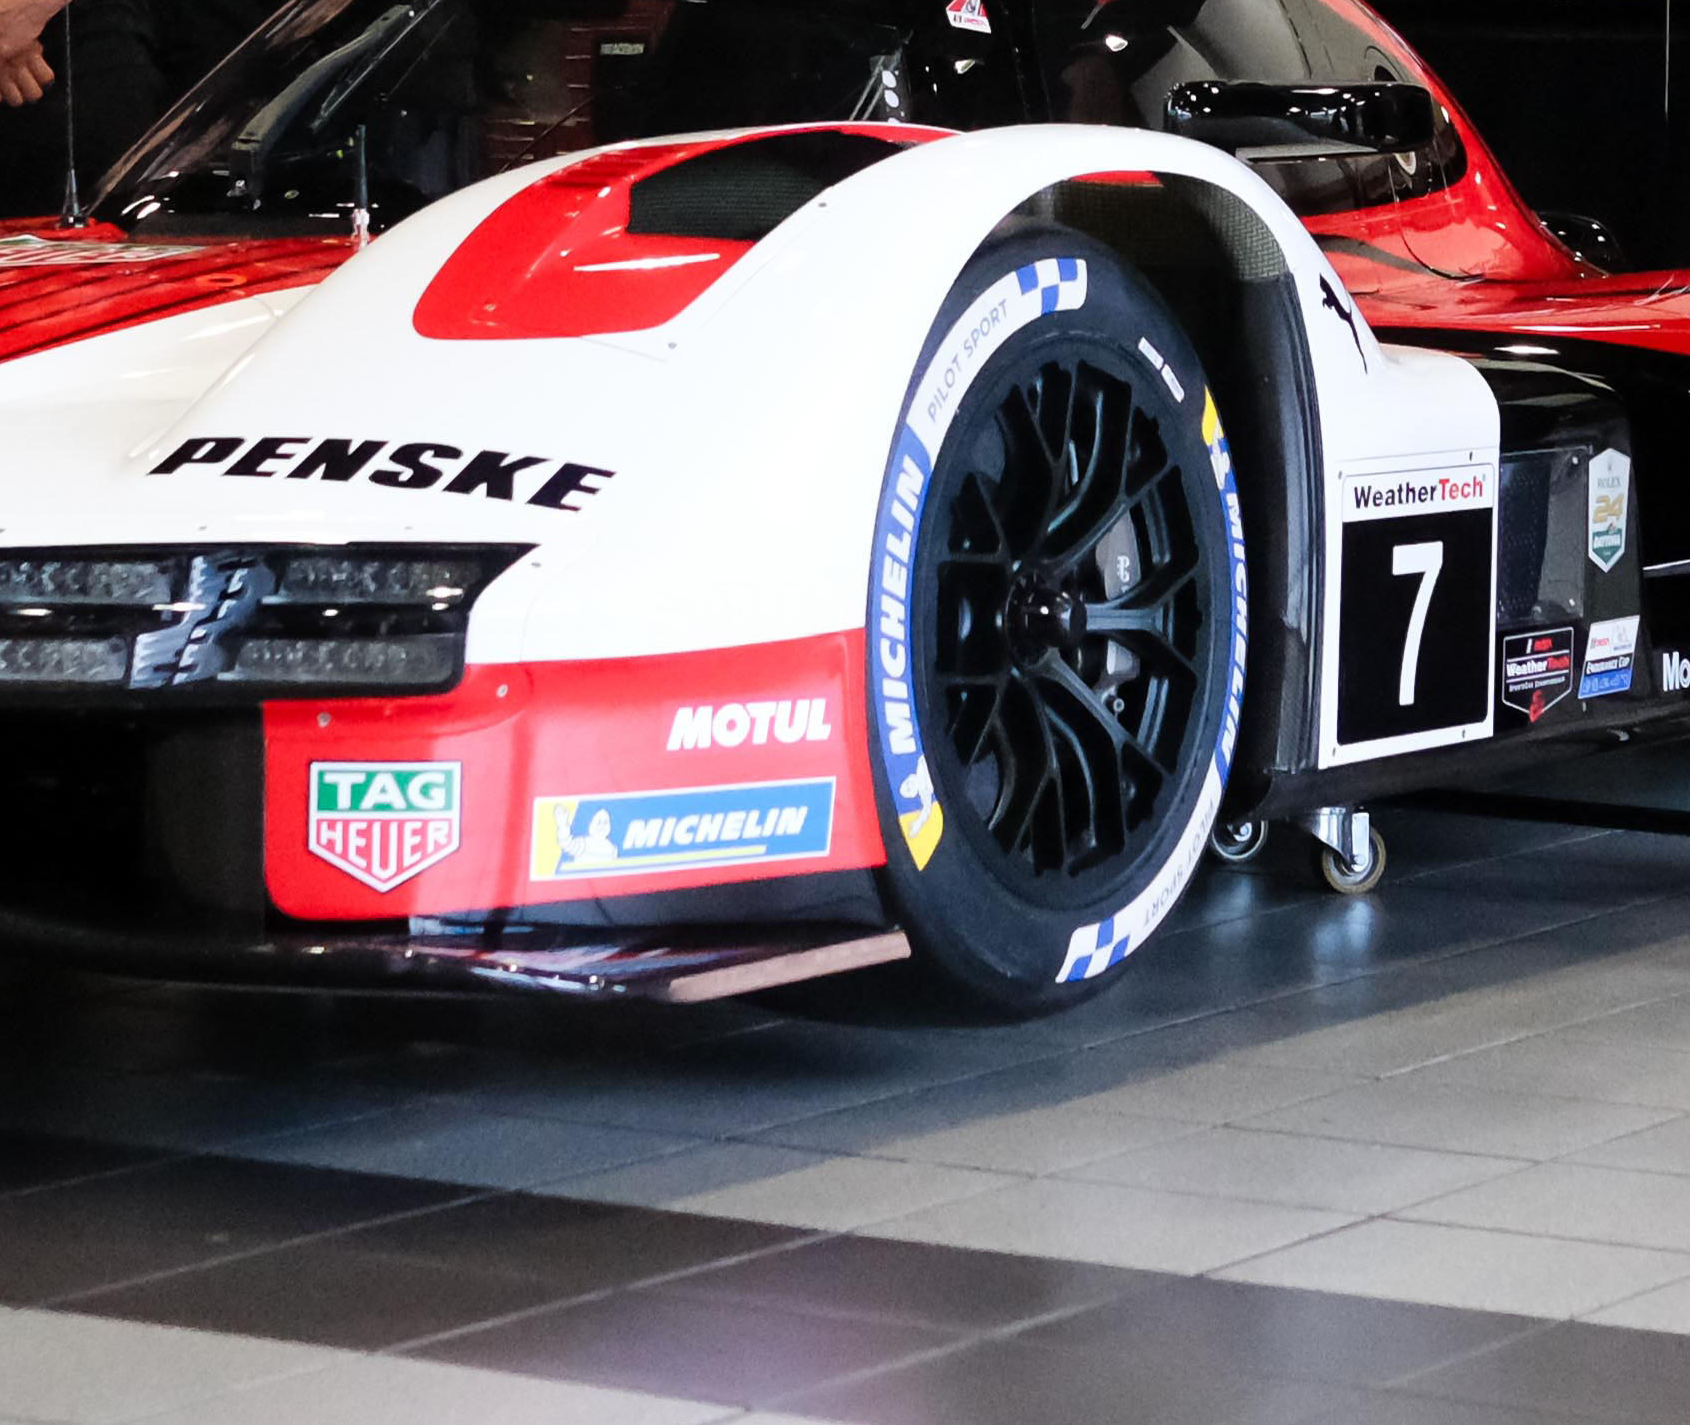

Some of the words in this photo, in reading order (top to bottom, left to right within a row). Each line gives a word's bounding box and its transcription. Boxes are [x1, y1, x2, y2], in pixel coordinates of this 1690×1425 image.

[963, 300, 1009, 362] SPORT
[927, 359, 964, 423] PILOT
[147, 436, 617, 512] PENSKE
[1354, 476, 1484, 509] WeatherTech
[1593, 494, 1624, 523] 24
[874, 454, 924, 758] MICHELIN
[1217, 492, 1248, 772] MICHELIN
[1392, 541, 1444, 706] 7
[1506, 656, 1570, 677] WeatherTech
[667, 699, 832, 751] MOTUL
[322, 773, 447, 811] TAG
[319, 818, 451, 884] HEUER
[622, 805, 807, 850] MICHELIN
